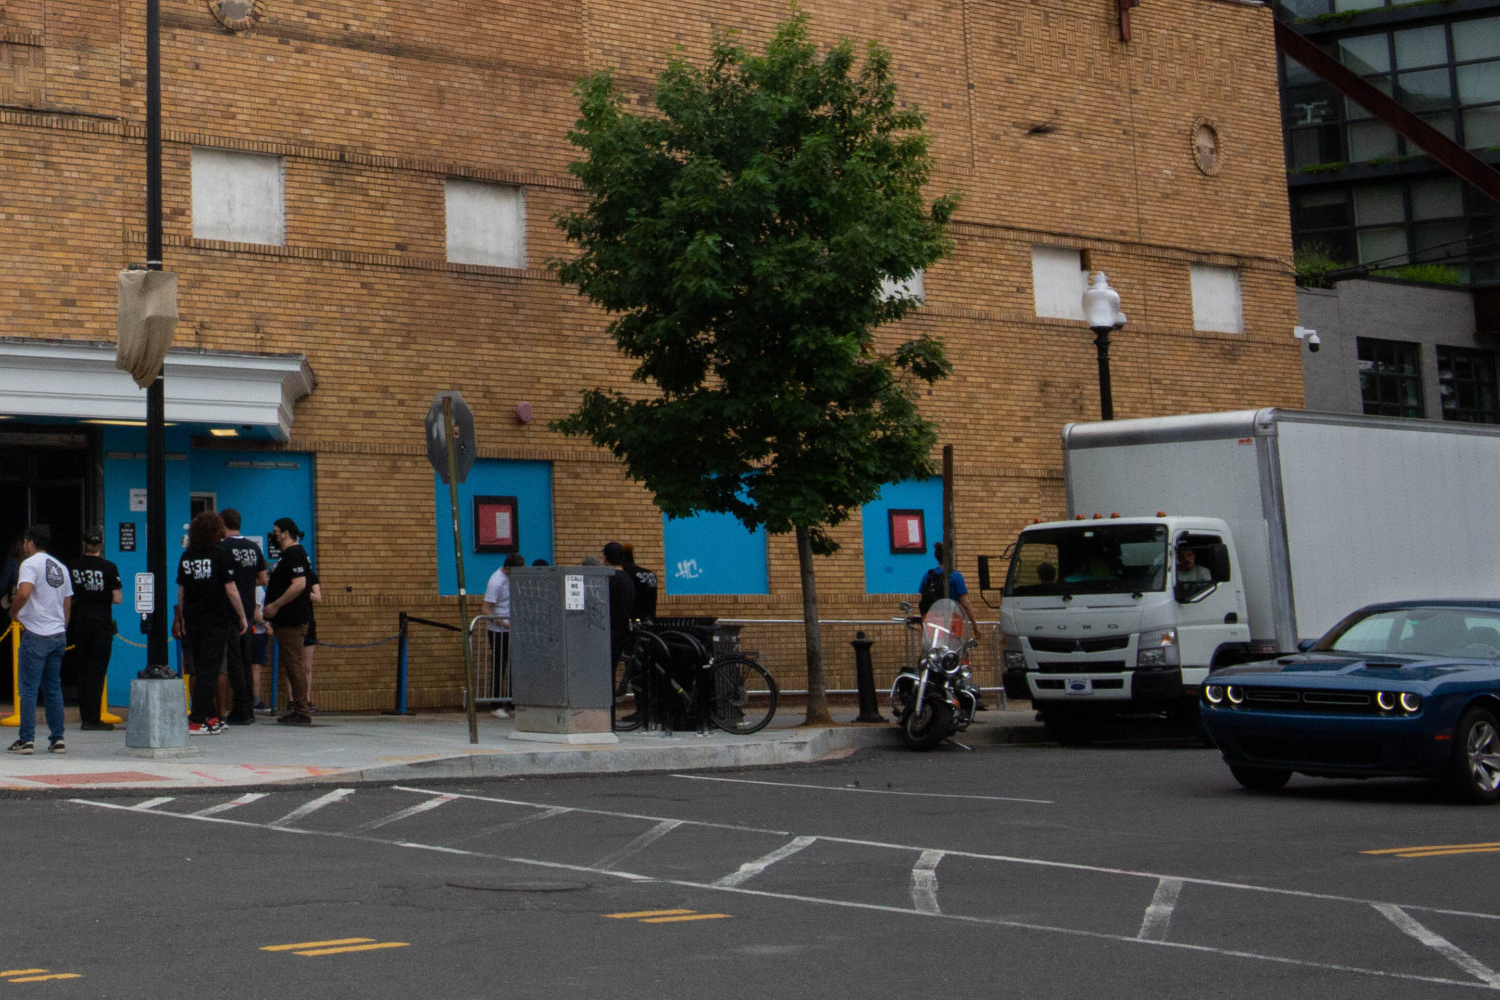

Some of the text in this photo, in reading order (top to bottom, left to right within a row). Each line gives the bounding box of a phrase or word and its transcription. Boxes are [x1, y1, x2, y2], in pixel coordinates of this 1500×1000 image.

[232, 548, 257, 561] 9:30
[182, 559, 211, 575] 9:30
[72, 569, 104, 586] 9:30
